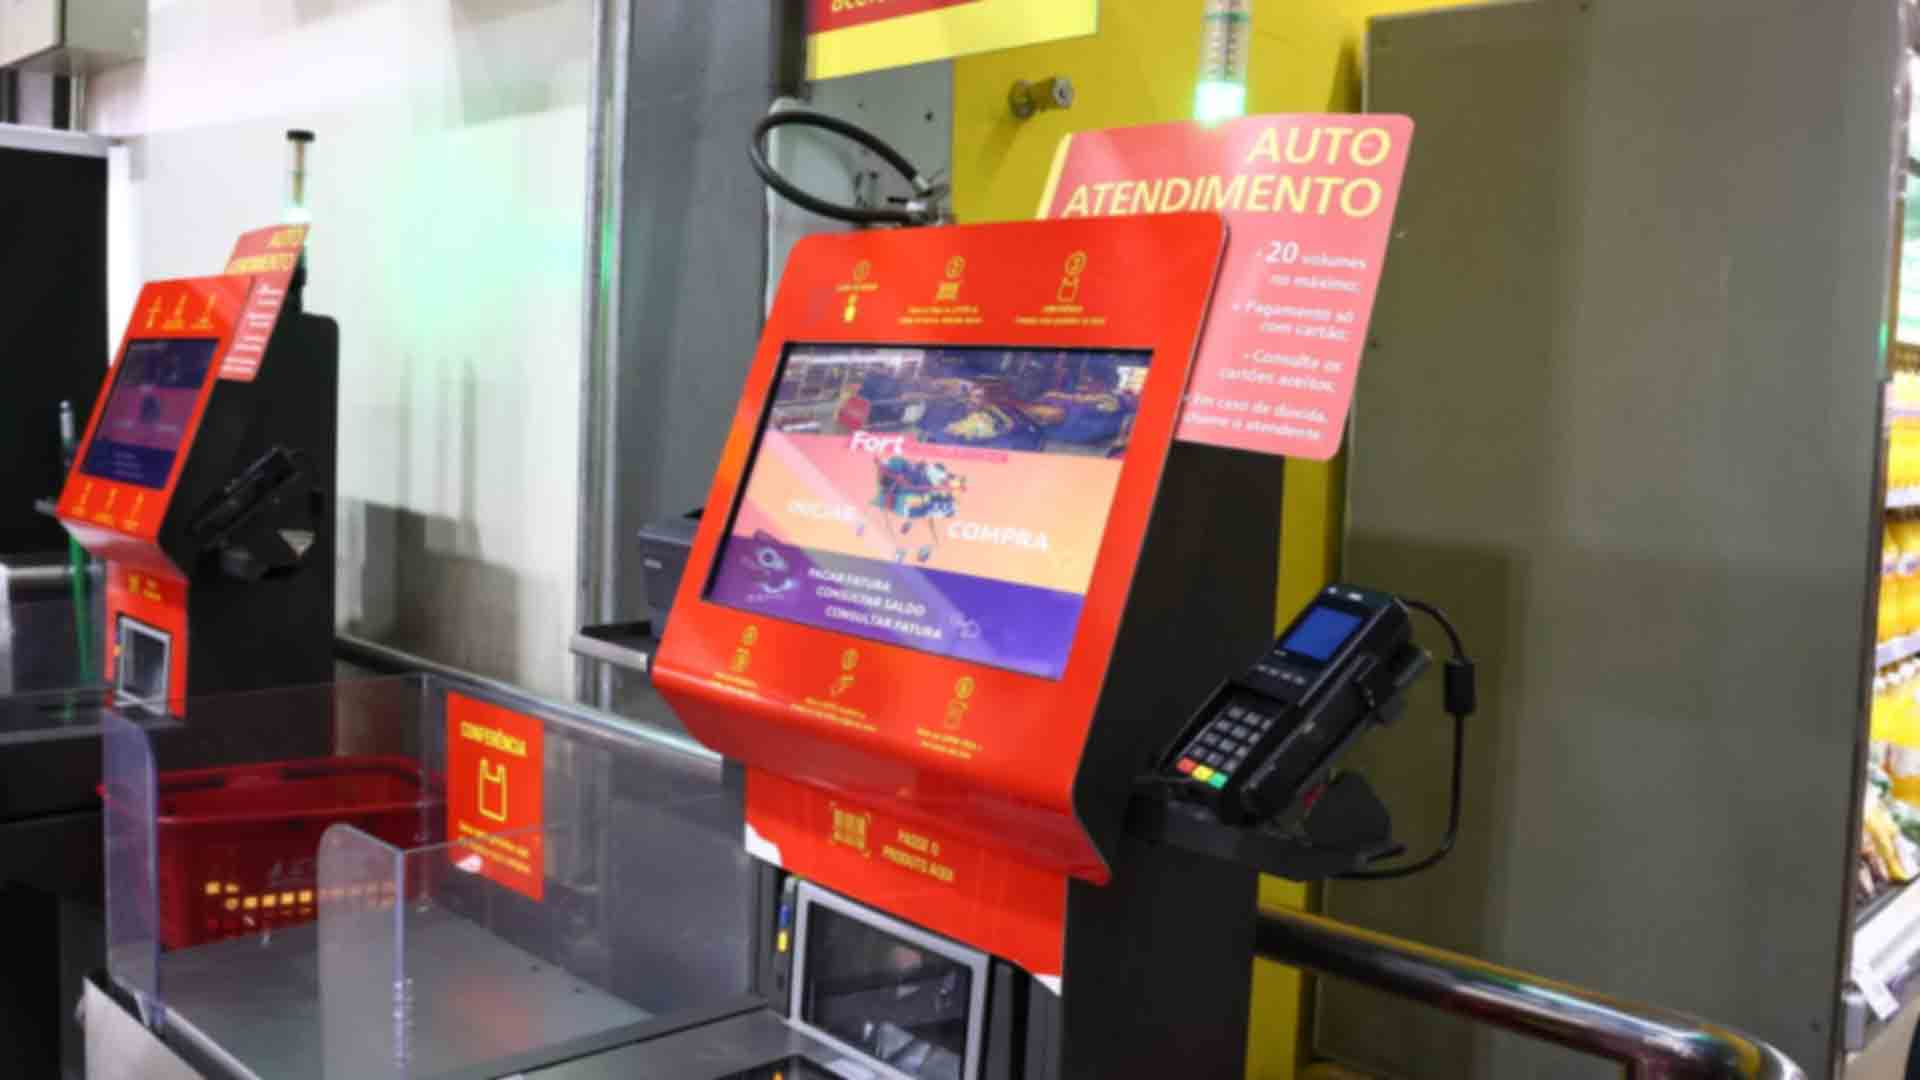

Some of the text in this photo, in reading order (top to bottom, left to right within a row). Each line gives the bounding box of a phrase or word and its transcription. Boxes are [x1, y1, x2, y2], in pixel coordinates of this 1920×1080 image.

[1247, 126, 1393, 167] AUTO
[1061, 174, 1383, 218] ATENDIMENTO
[1264, 240, 1366, 270] 20 volumes
[1269, 275, 1290, 289] no
[1245, 298, 1329, 323] Pagamento
[1259, 321, 1292, 335] com
[1252, 349, 1319, 371] Consulte
[1252, 400, 1270, 415] de
[850, 430, 904, 454] Fort
[947, 521, 1050, 552] COMPRA
[846, 573, 892, 593] FATURA
[816, 585, 927, 617] CONSULTAR SALDO
[825, 604, 944, 641] CONSULTAR FATURA
